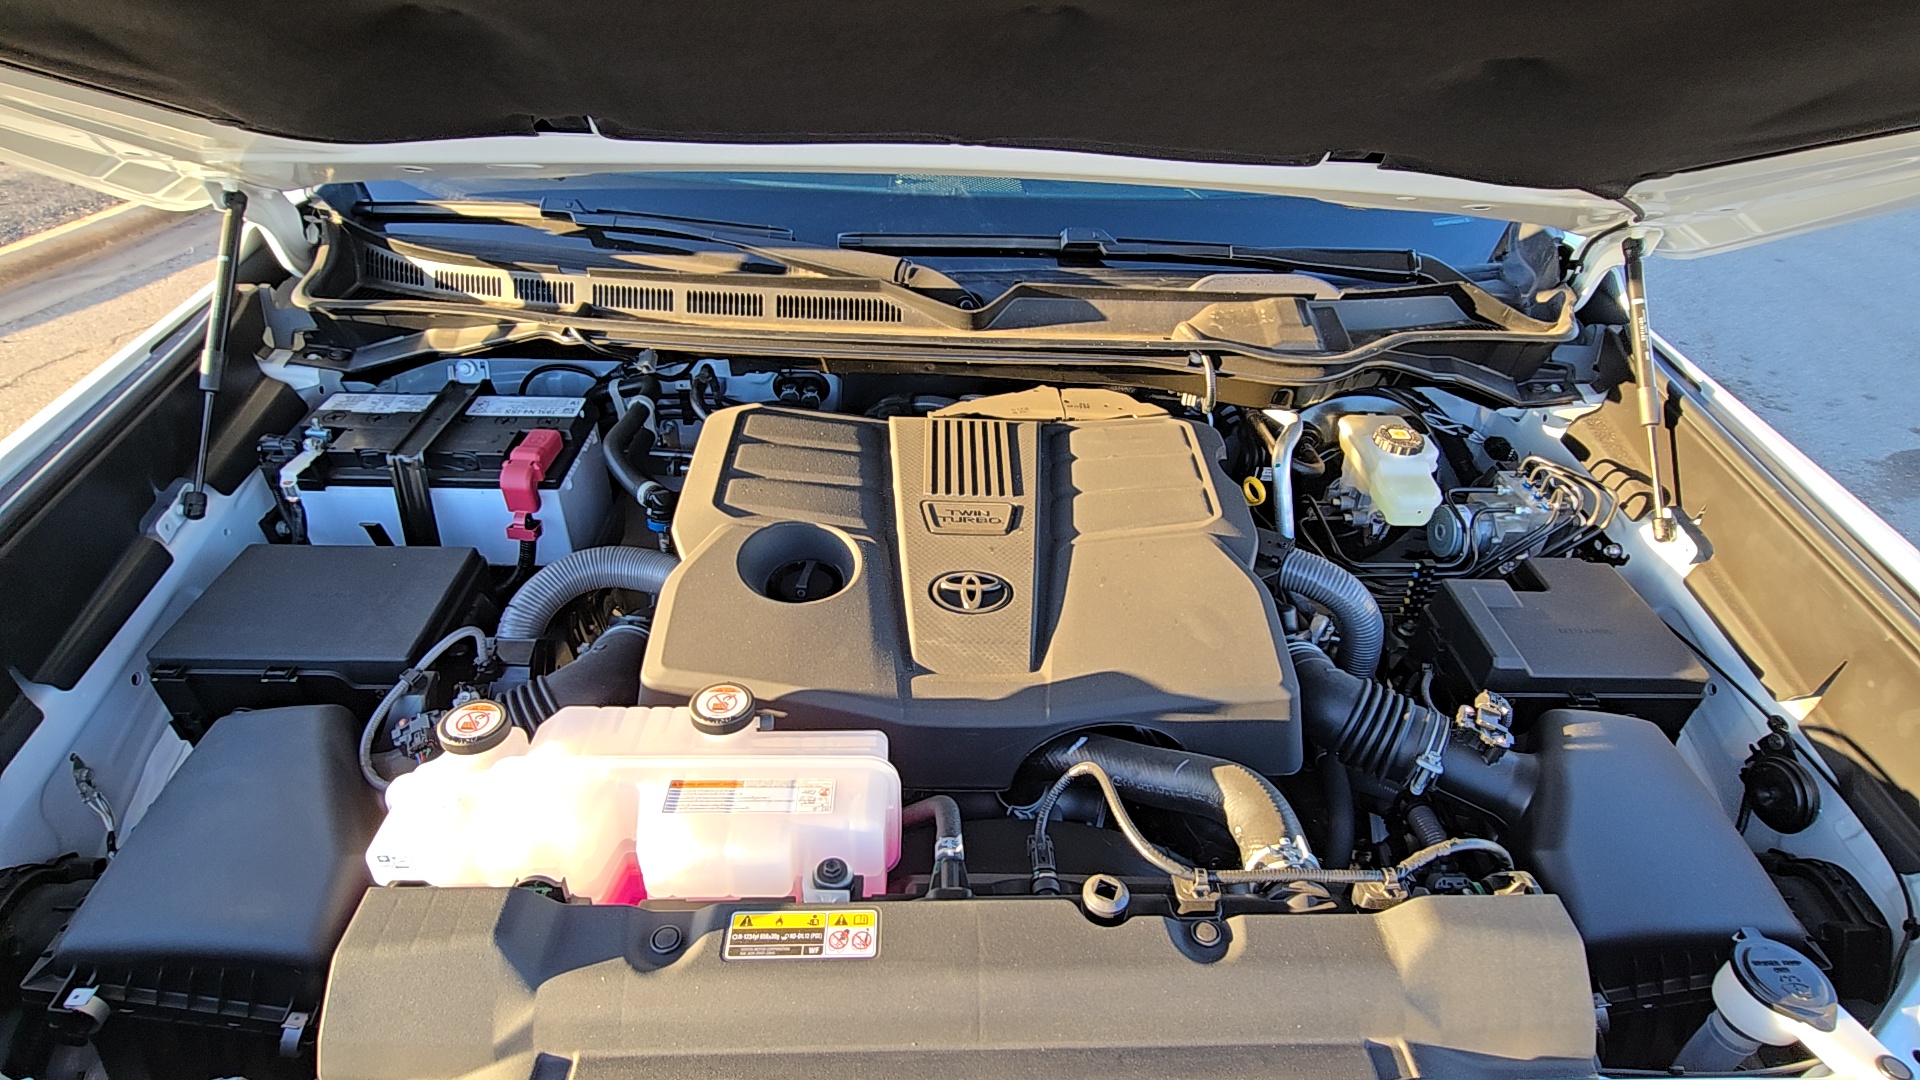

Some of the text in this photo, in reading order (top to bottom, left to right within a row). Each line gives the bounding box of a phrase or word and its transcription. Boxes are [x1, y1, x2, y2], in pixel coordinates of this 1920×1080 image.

[945, 509, 990, 517] TWIN
[938, 516, 1002, 524] TURBO
[808, 946, 820, 954] WF
